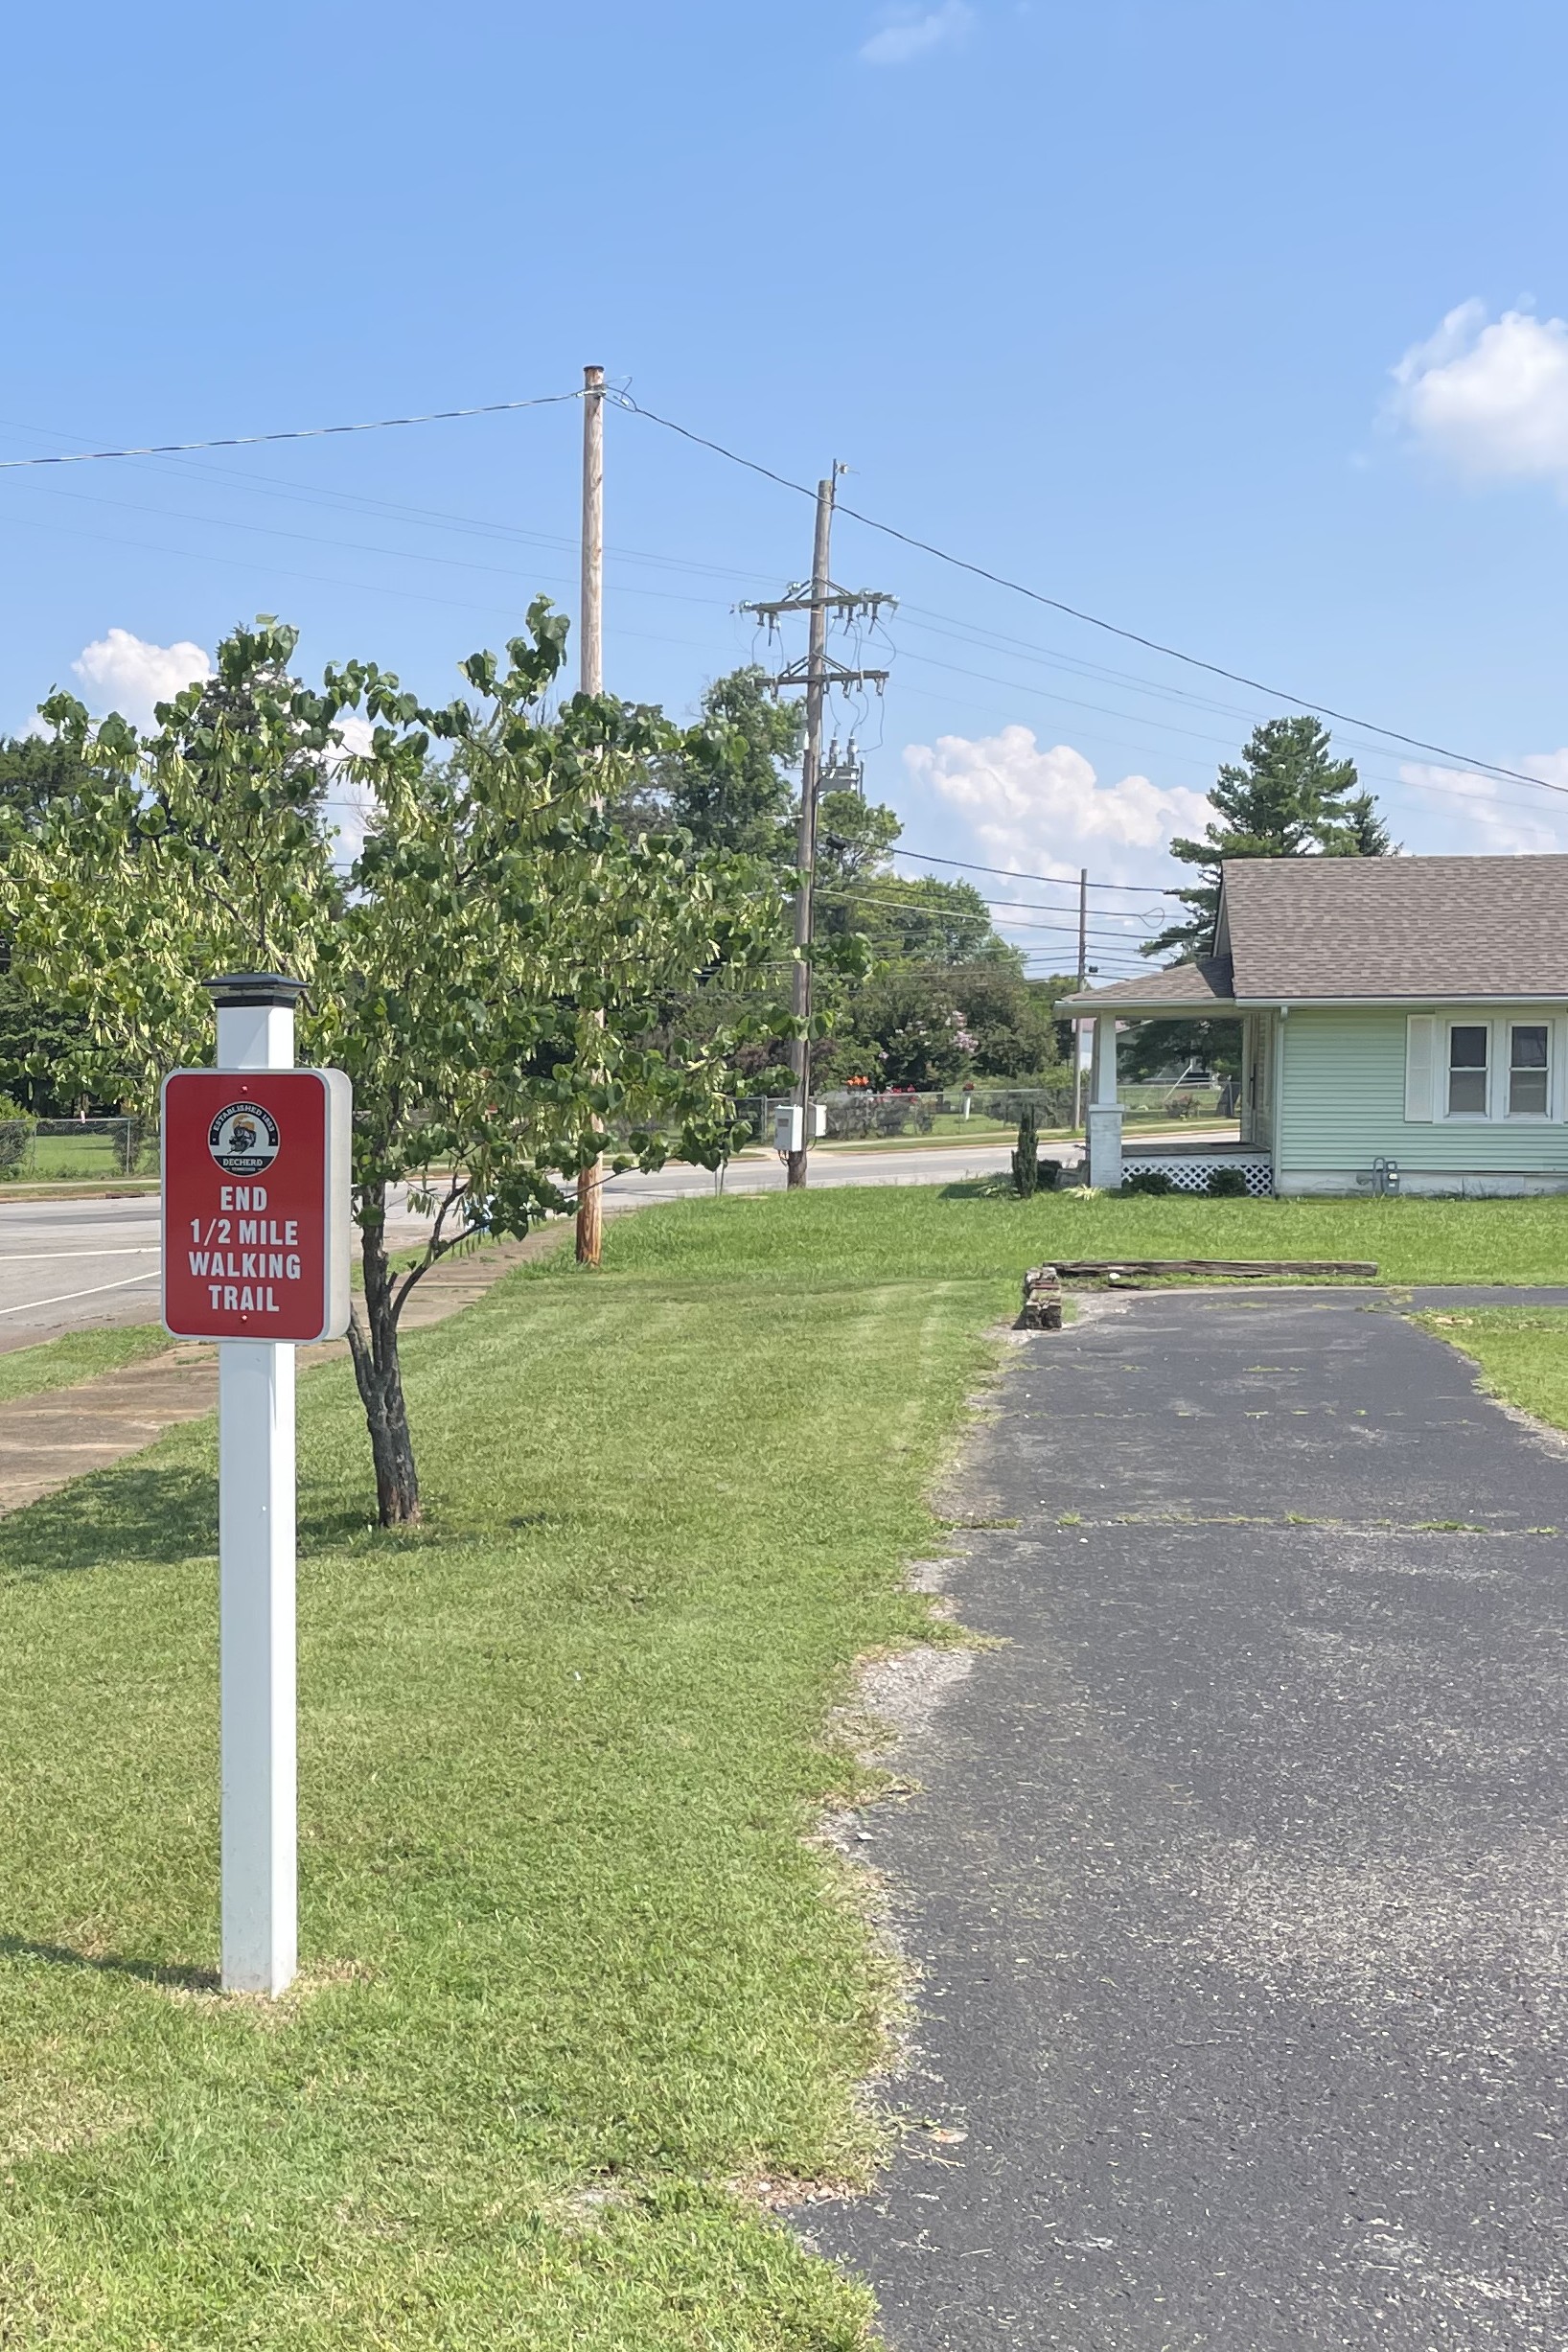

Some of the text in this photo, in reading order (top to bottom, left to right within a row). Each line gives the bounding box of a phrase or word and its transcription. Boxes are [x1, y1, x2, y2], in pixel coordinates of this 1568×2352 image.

[213, 1104, 263, 1132] ESTABLISHED
[222, 1158, 264, 1166] DECHERD
[220, 1186, 268, 1211] END
[190, 1218, 299, 1247] 1/2 MILE
[188, 1251, 302, 1280] WALKING
[208, 1284, 280, 1312] TRAIL
